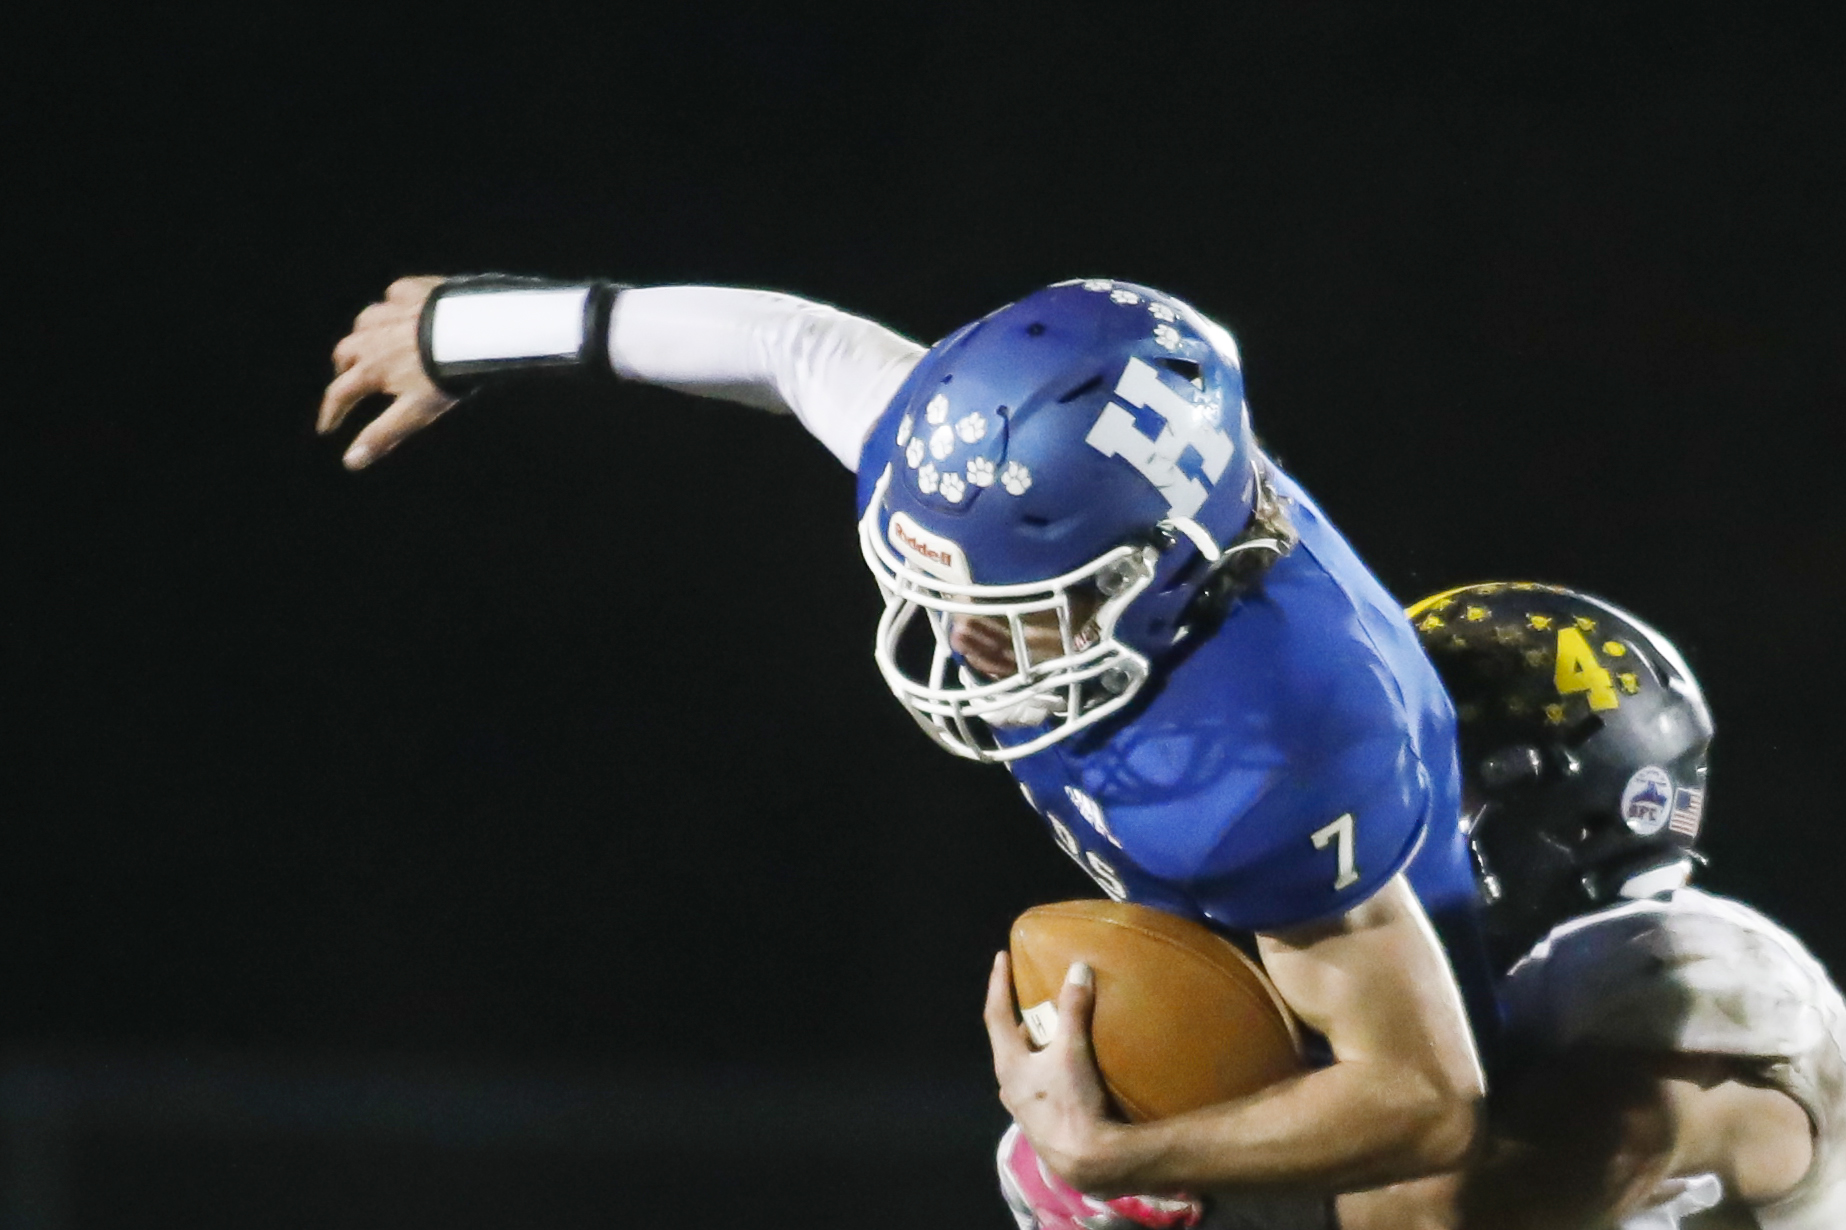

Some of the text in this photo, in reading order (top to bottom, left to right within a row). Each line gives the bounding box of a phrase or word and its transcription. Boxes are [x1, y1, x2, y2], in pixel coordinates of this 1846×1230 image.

[1085, 356, 1235, 519] H
[895, 522, 951, 567] Riddell
[1554, 627, 1619, 710] 4
[1311, 813, 1359, 891] 7
